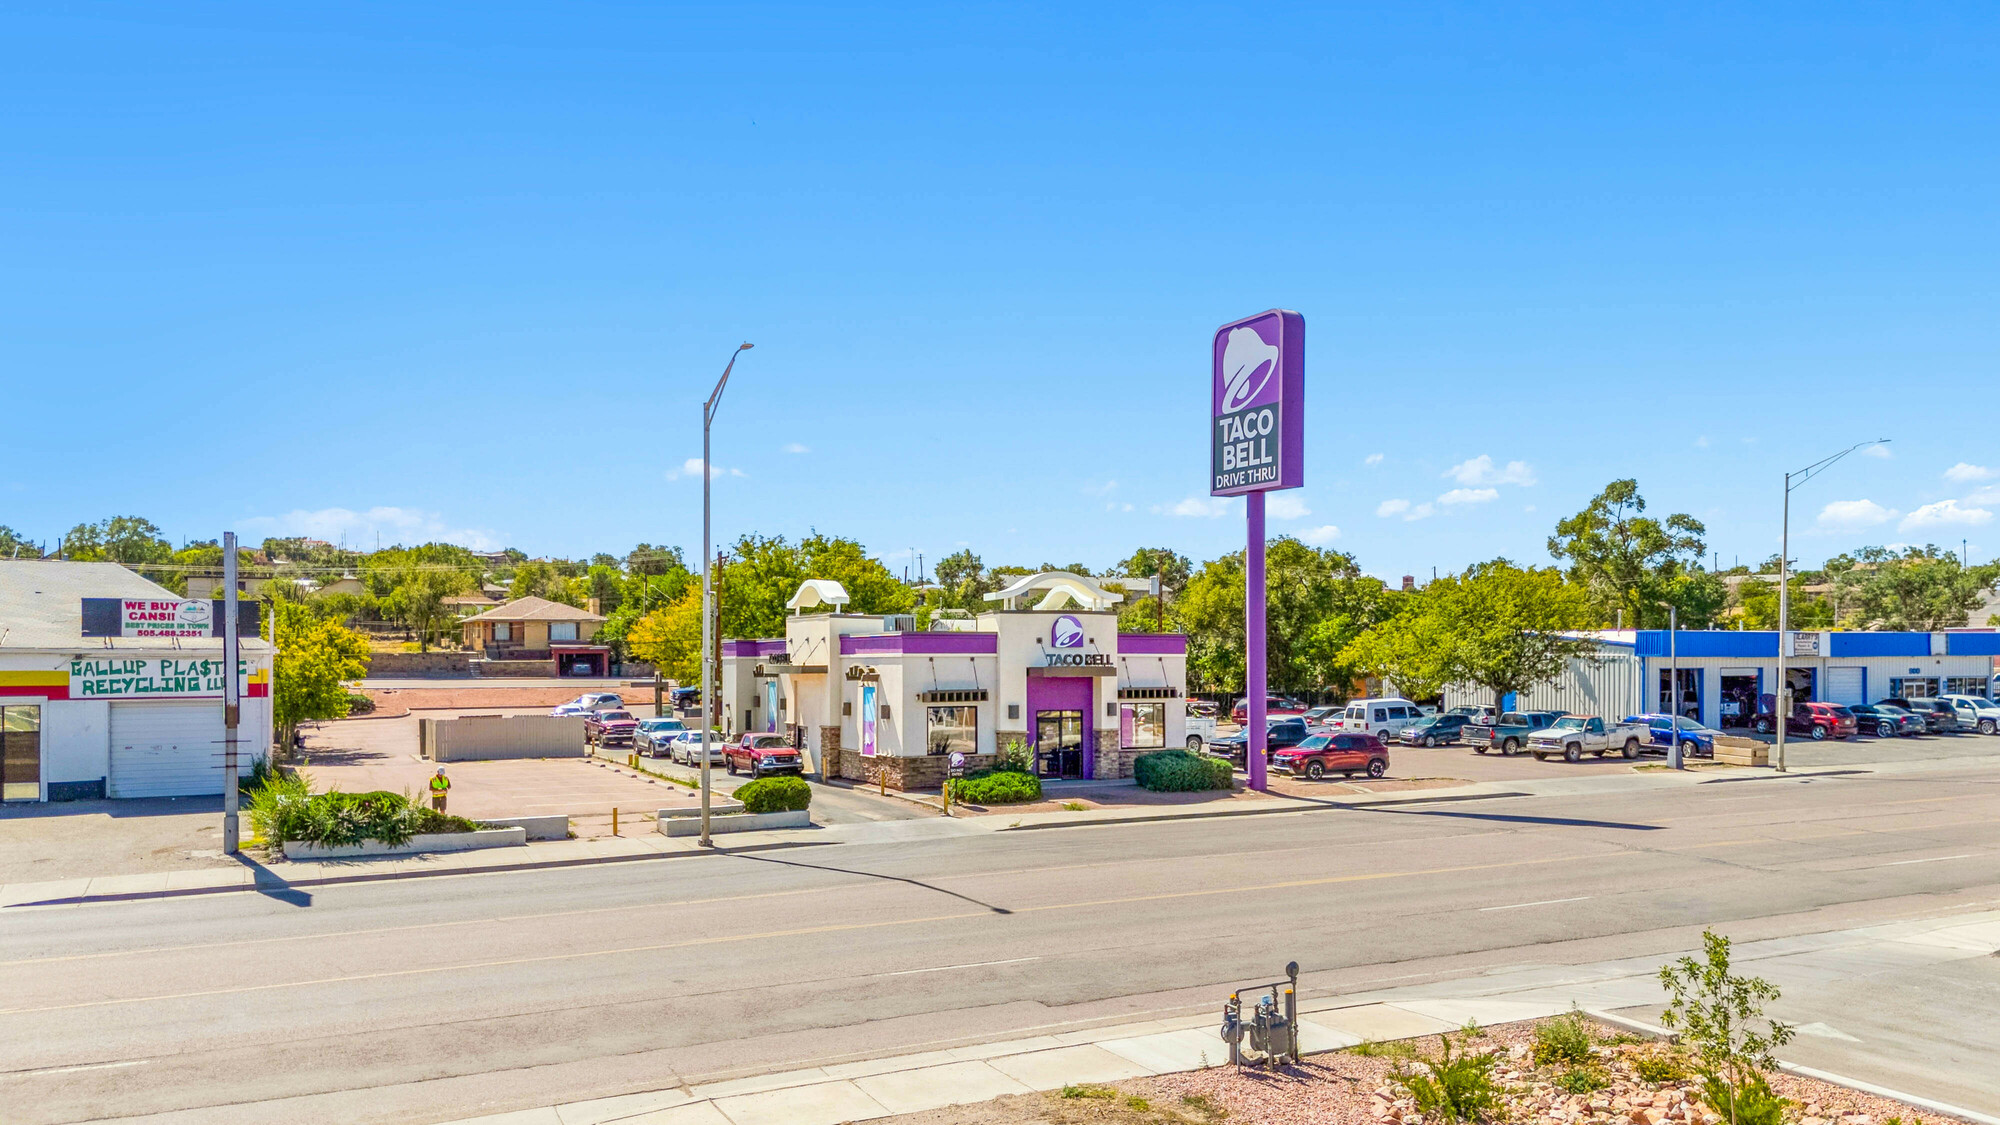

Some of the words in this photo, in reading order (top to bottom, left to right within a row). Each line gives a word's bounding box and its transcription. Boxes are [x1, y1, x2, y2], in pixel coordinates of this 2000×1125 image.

[1220, 409, 1274, 443] TACO
[1223, 438, 1273, 471] BELL
[1216, 471, 1246, 488] DRIVE
[1247, 466, 1276, 483] THRU
[125, 602, 146, 610] WE
[150, 602, 179, 611] BUY
[147, 622, 175, 630] PRICES
[187, 622, 209, 630] TOWN
[71, 659, 147, 677] GALLUP
[1046, 653, 1083, 667] TACO
[1084, 653, 1114, 666] BELL
[82, 677, 200, 695] RECYCLING
